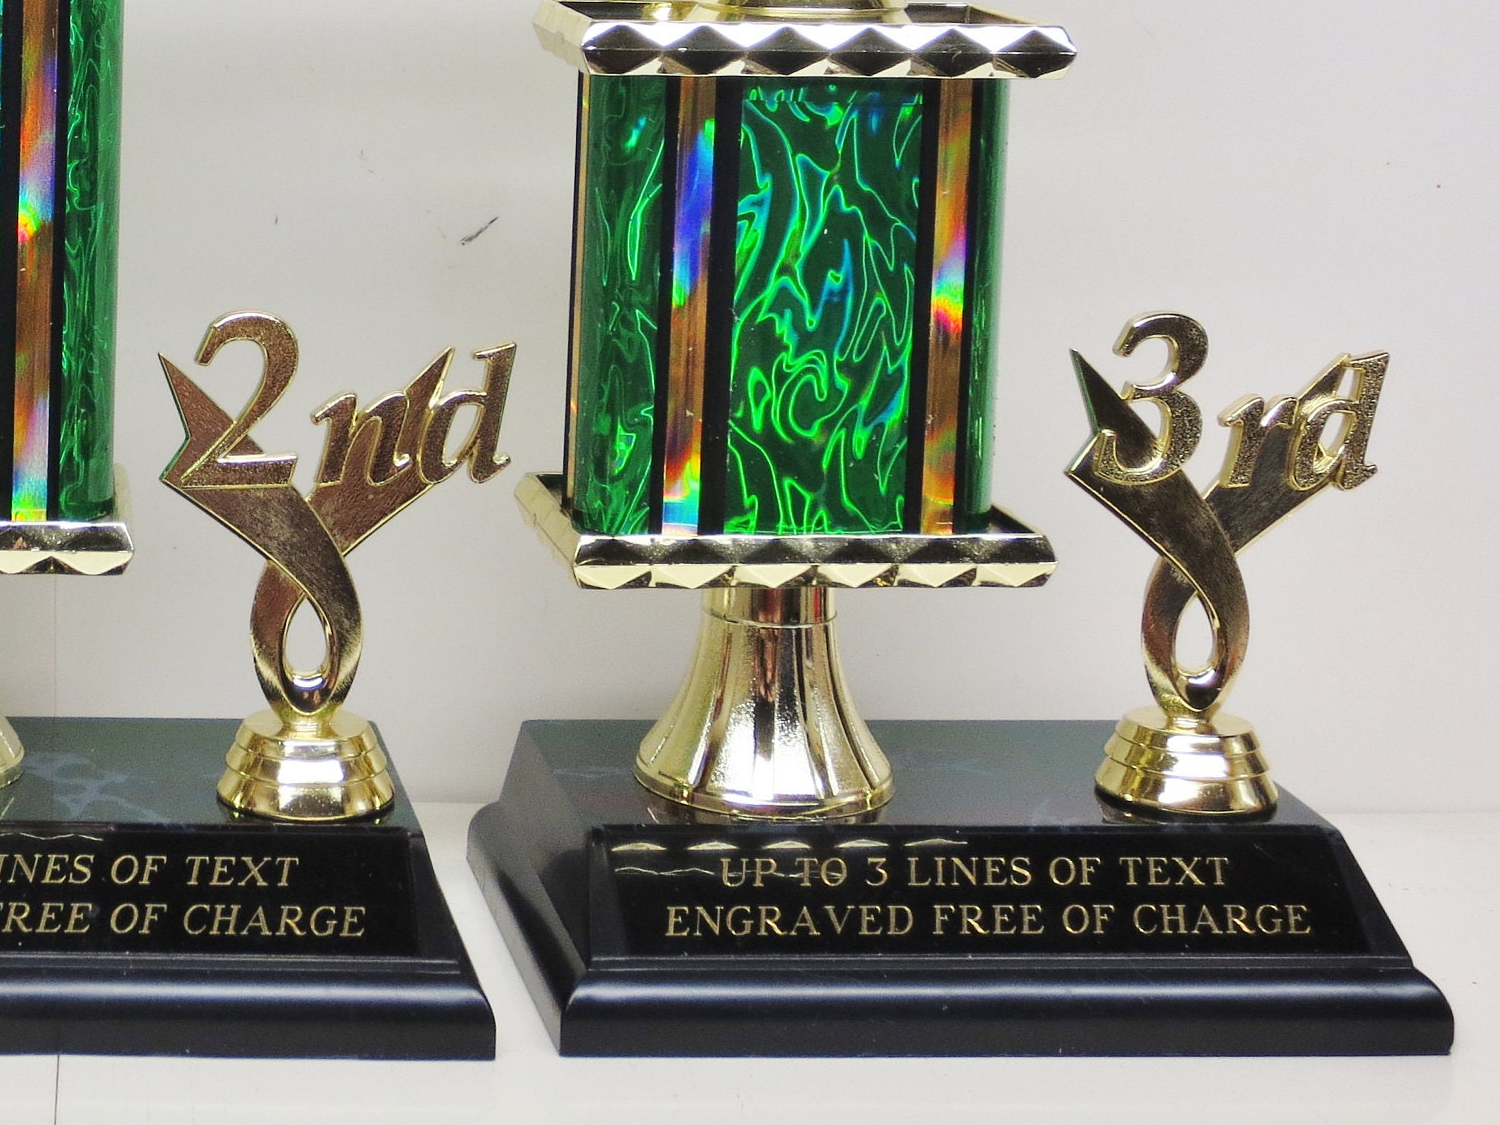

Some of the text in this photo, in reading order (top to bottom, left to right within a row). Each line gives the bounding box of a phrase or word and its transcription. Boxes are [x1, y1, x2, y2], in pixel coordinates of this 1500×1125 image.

[180, 309, 517, 488] 2nd
[1093, 311, 1390, 490] 3rd
[110, 854, 168, 885] OF
[184, 855, 300, 887] TEXT
[720, 856, 1230, 888] UP TO 3 LINES OF TEXT
[110, 903, 169, 935] OF
[183, 903, 367, 937] CHARGE
[665, 904, 1313, 937] ENGRAVED FREE OF CHARGE
